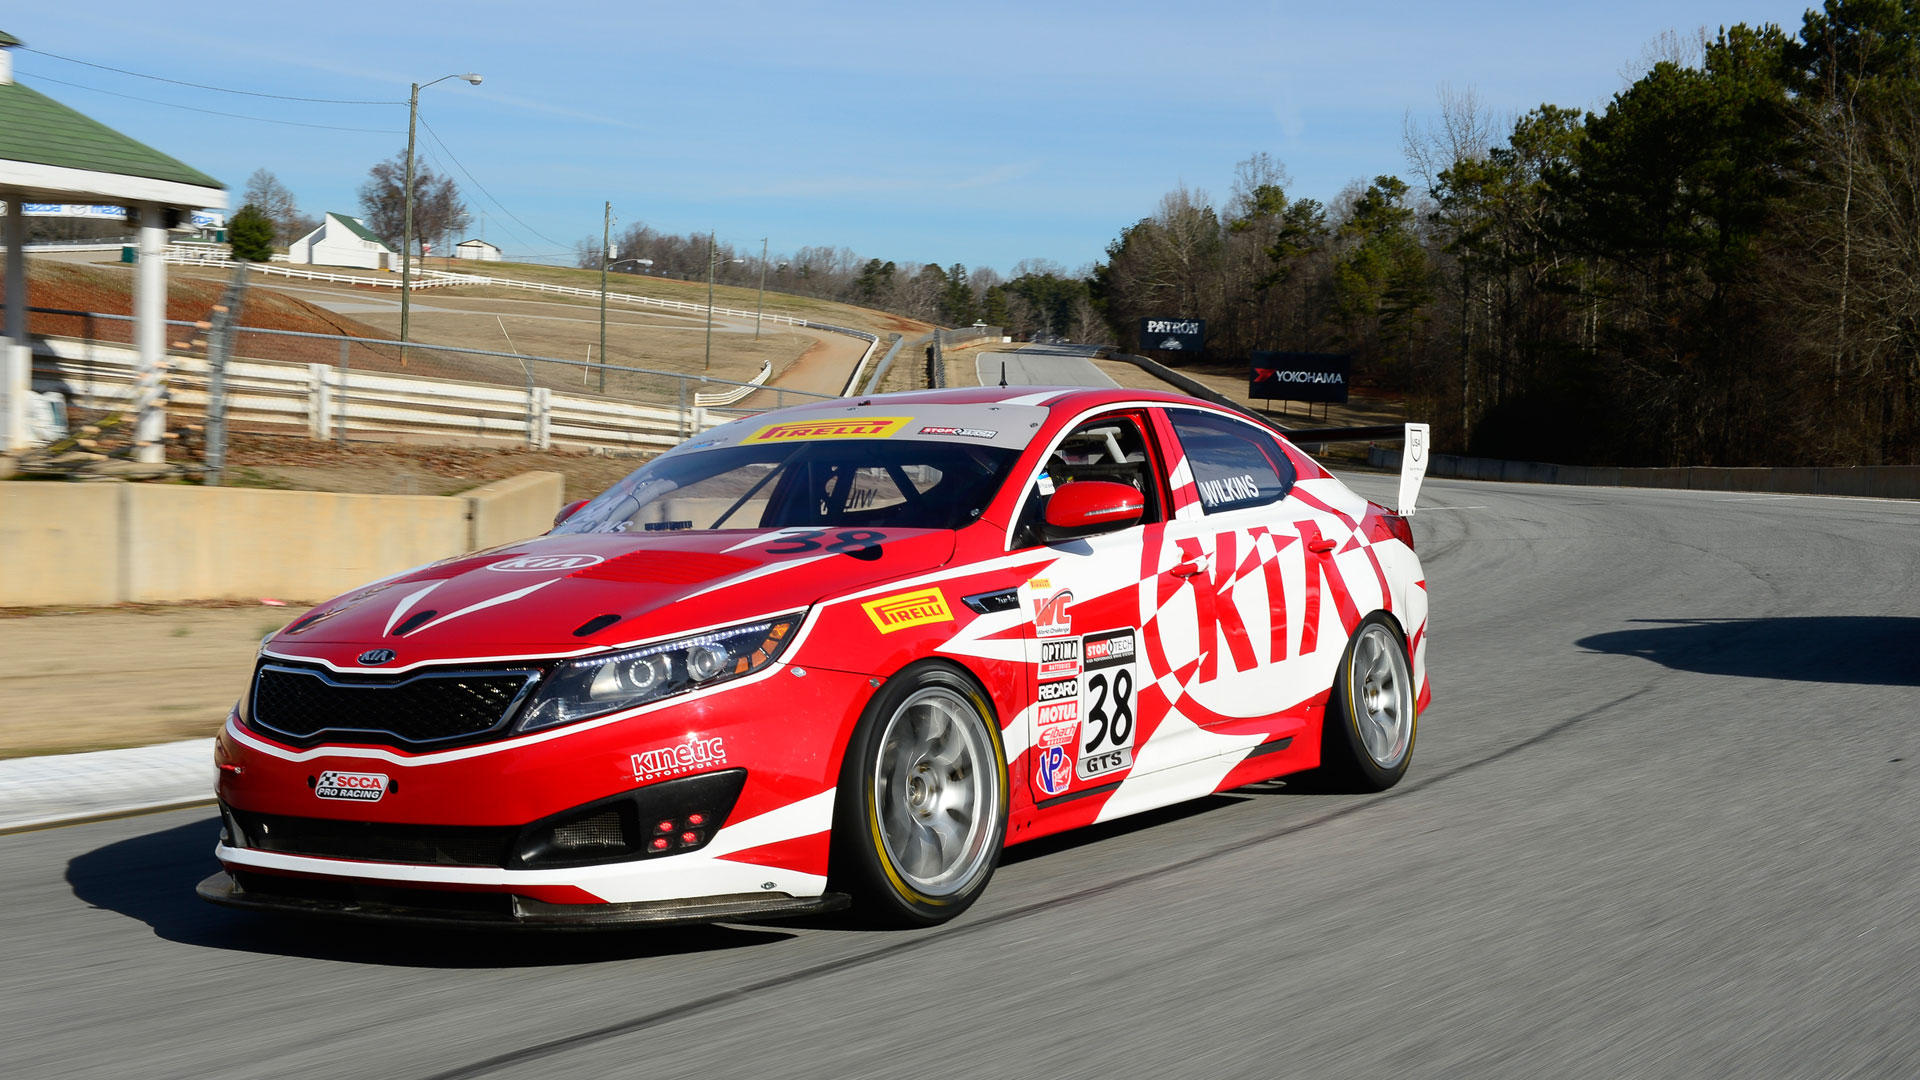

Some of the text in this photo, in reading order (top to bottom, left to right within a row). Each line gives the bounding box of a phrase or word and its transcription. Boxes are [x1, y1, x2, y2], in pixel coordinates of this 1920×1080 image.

[1276, 370, 1343, 384] YOKOHAMA
[758, 420, 894, 440] PIRELLI
[1201, 474, 1260, 507] WILKINS
[765, 530, 887, 561] 38
[499, 557, 584, 568] KIA
[873, 595, 945, 626] PIRELLI
[1033, 595, 1072, 627] WC
[1175, 519, 1363, 685] KIA
[359, 650, 390, 661] KIA
[1042, 641, 1077, 662] OPTIMA
[1038, 680, 1078, 700] RECARO
[1039, 703, 1077, 724] MOTUL
[1085, 668, 1133, 754] 38
[635, 758, 728, 782] MOTORSPORTS
[1040, 746, 1063, 793] VP
[1086, 751, 1123, 773] GTS
[336, 775, 382, 789] SCCA
[317, 787, 380, 799] PRO RACING
